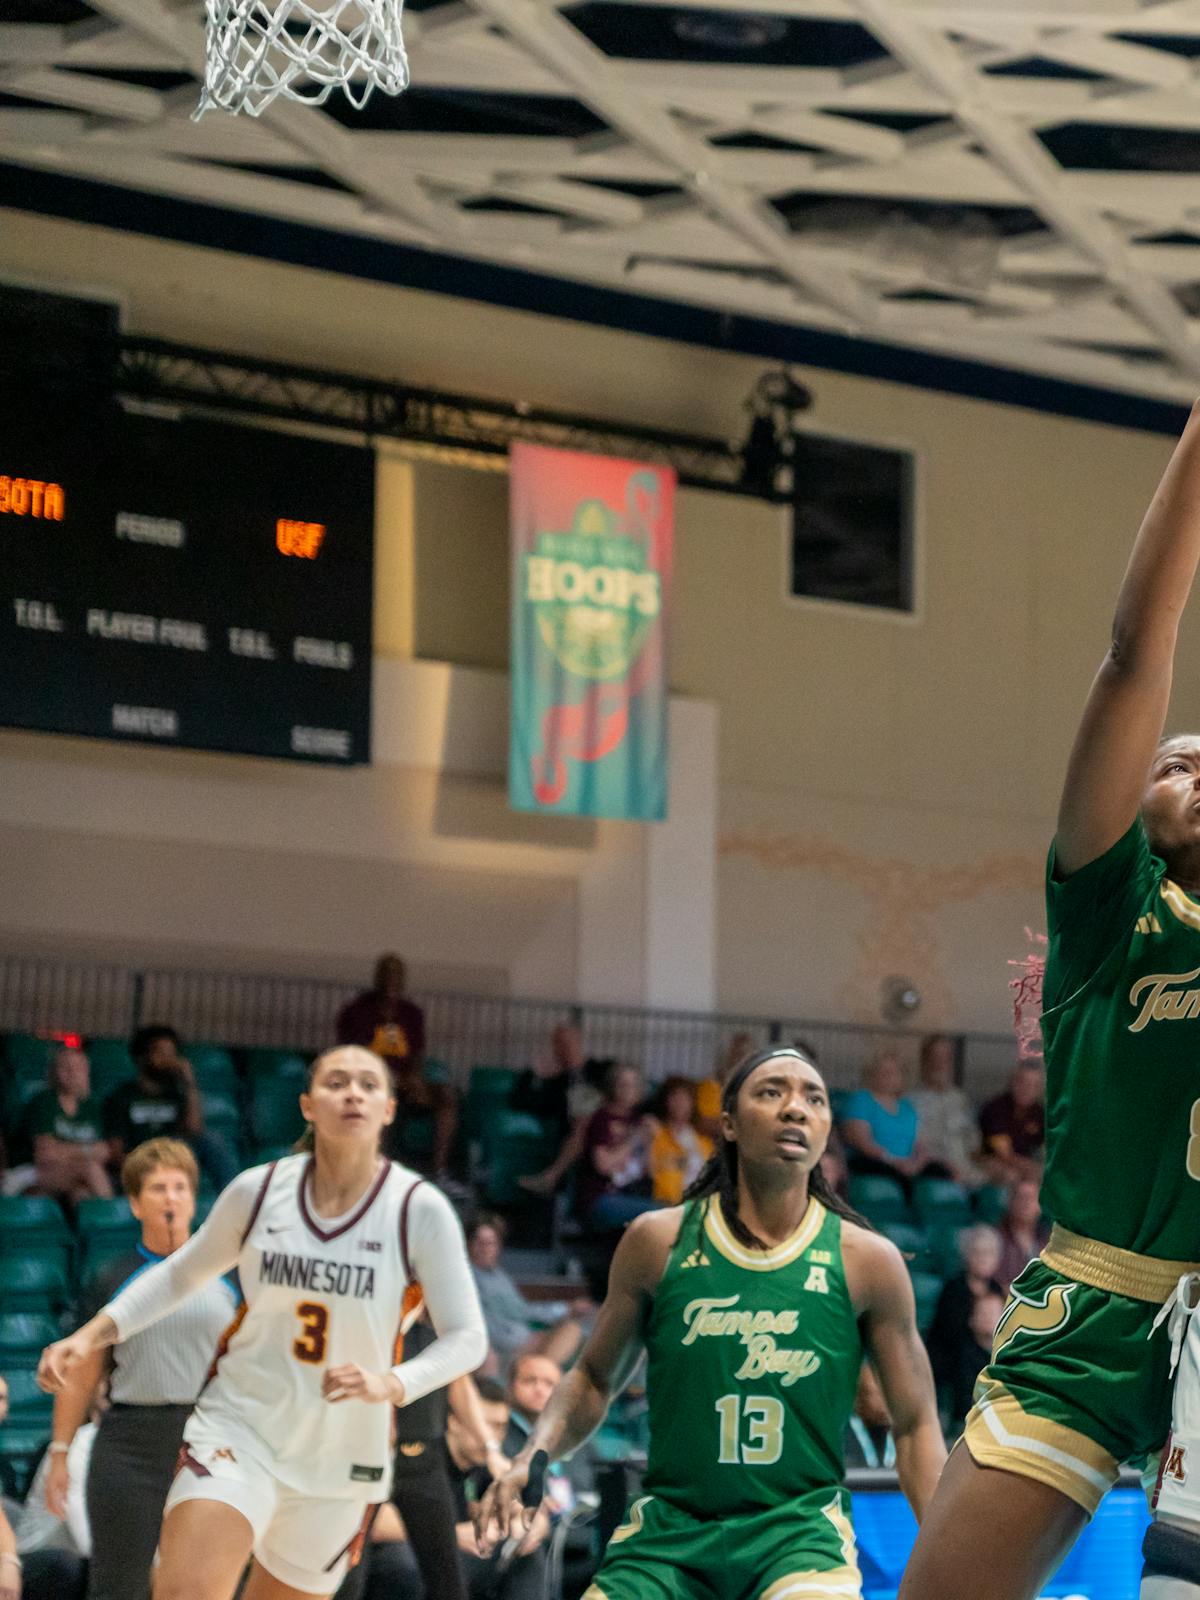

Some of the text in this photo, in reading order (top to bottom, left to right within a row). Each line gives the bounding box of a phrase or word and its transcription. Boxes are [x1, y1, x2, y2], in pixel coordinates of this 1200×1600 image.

[276, 518, 326, 560] USF
[526, 557, 660, 616] HOOPS
[86, 607, 207, 652] PLAYER FOUL
[259, 1250, 375, 1300] MINNESOTA
[293, 1301, 329, 1365] 3
[681, 1294, 799, 1346] Tampa
[734, 1334, 821, 1387] Bay
[714, 1394, 784, 1465] 13
